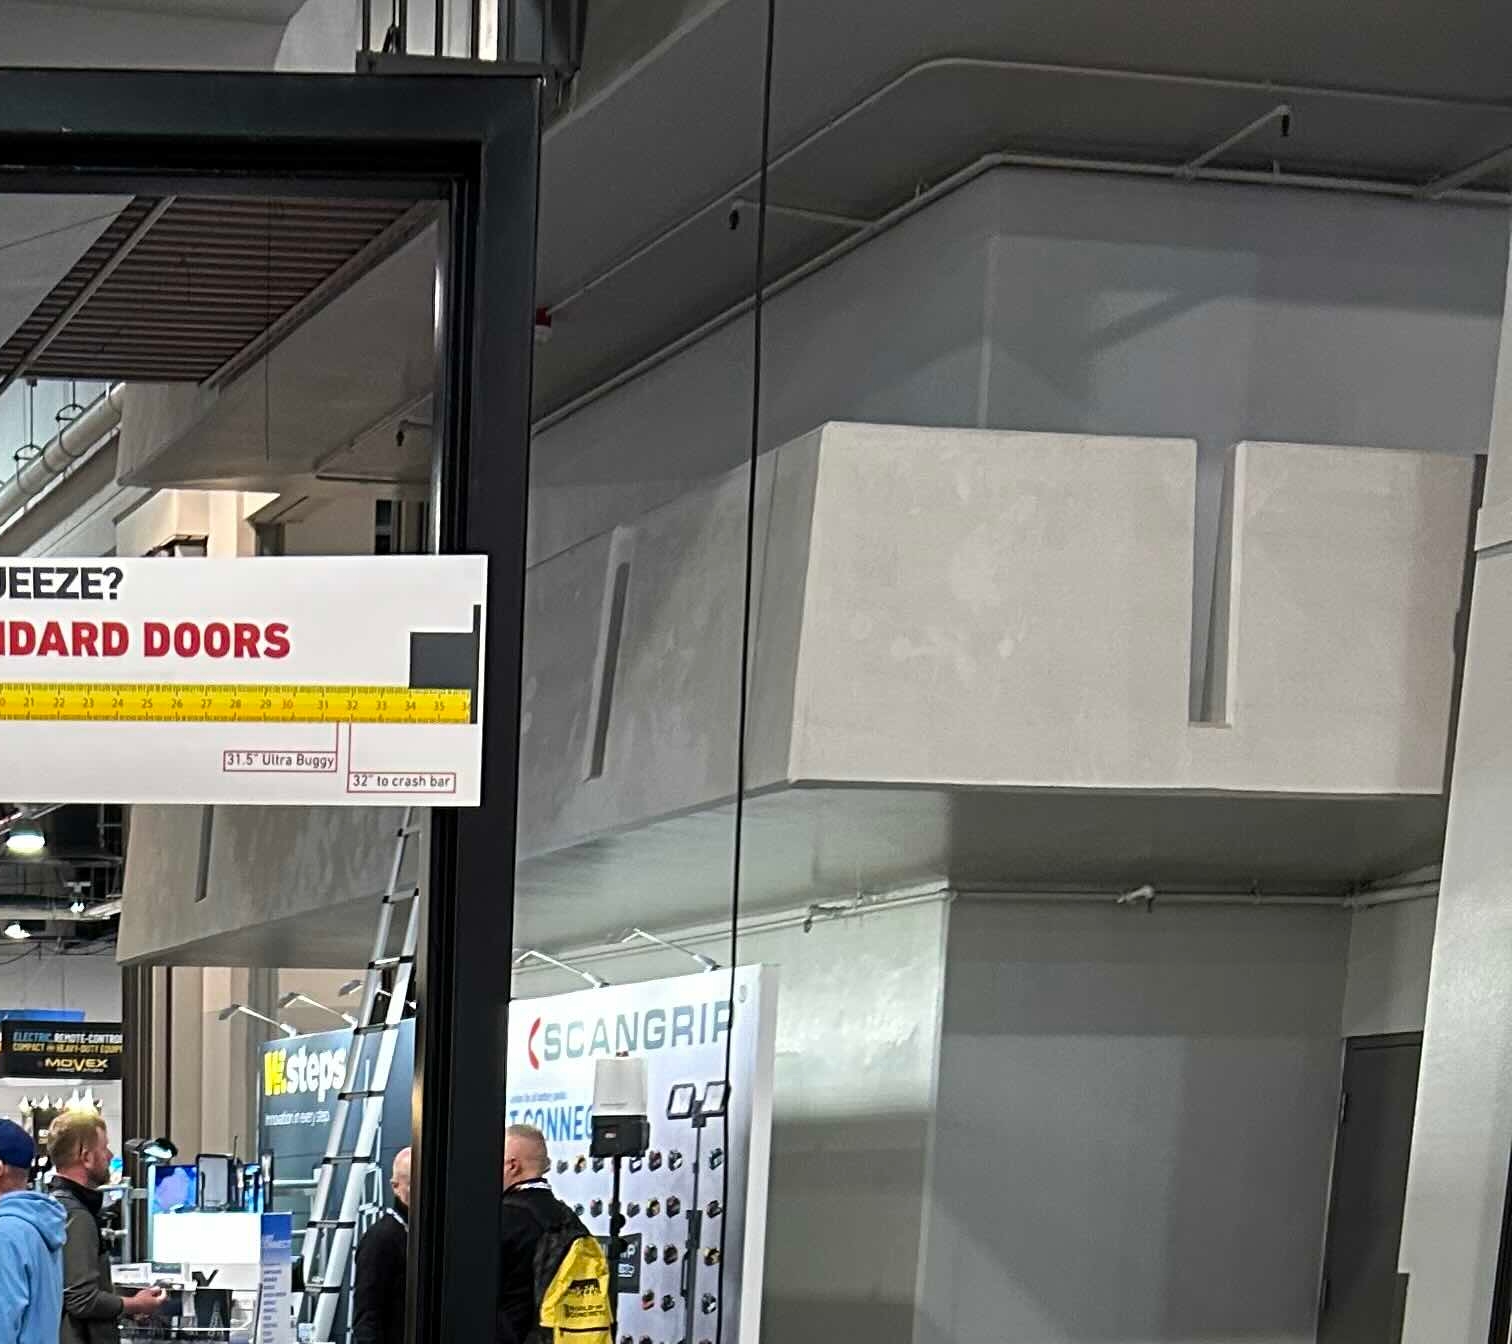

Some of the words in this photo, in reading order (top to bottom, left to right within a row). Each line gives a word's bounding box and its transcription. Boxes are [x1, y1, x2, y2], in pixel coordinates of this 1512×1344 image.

[143, 622, 291, 660] DOORS
[23, 696, 35, 708] 21
[52, 697, 65, 709] 22
[82, 697, 95, 709] 23
[111, 697, 124, 709] 24
[141, 698, 154, 709] 25
[170, 698, 184, 709] 26
[200, 698, 213, 710] 27
[229, 698, 242, 710] 28
[259, 698, 272, 710] 29
[282, 699, 294, 710] 30
[317, 699, 329, 711] 31
[347, 699, 359, 711] 32
[375, 700, 387, 711] 33
[404, 700, 417, 712] 34
[433, 700, 446, 712] 35
[226, 753, 259, 766] 31.5"
[262, 753, 292, 766] Ultra
[296, 754, 335, 769] Buggy
[353, 774, 373, 787] 32"
[377, 775, 388, 787] to
[392, 775, 426, 787] crash
[430, 776, 450, 788] bar
[544, 1001, 731, 1061] SCANGRIP
[44, 1058, 109, 1073] MOVEX
[523, 1104, 594, 1143] CONNEC
